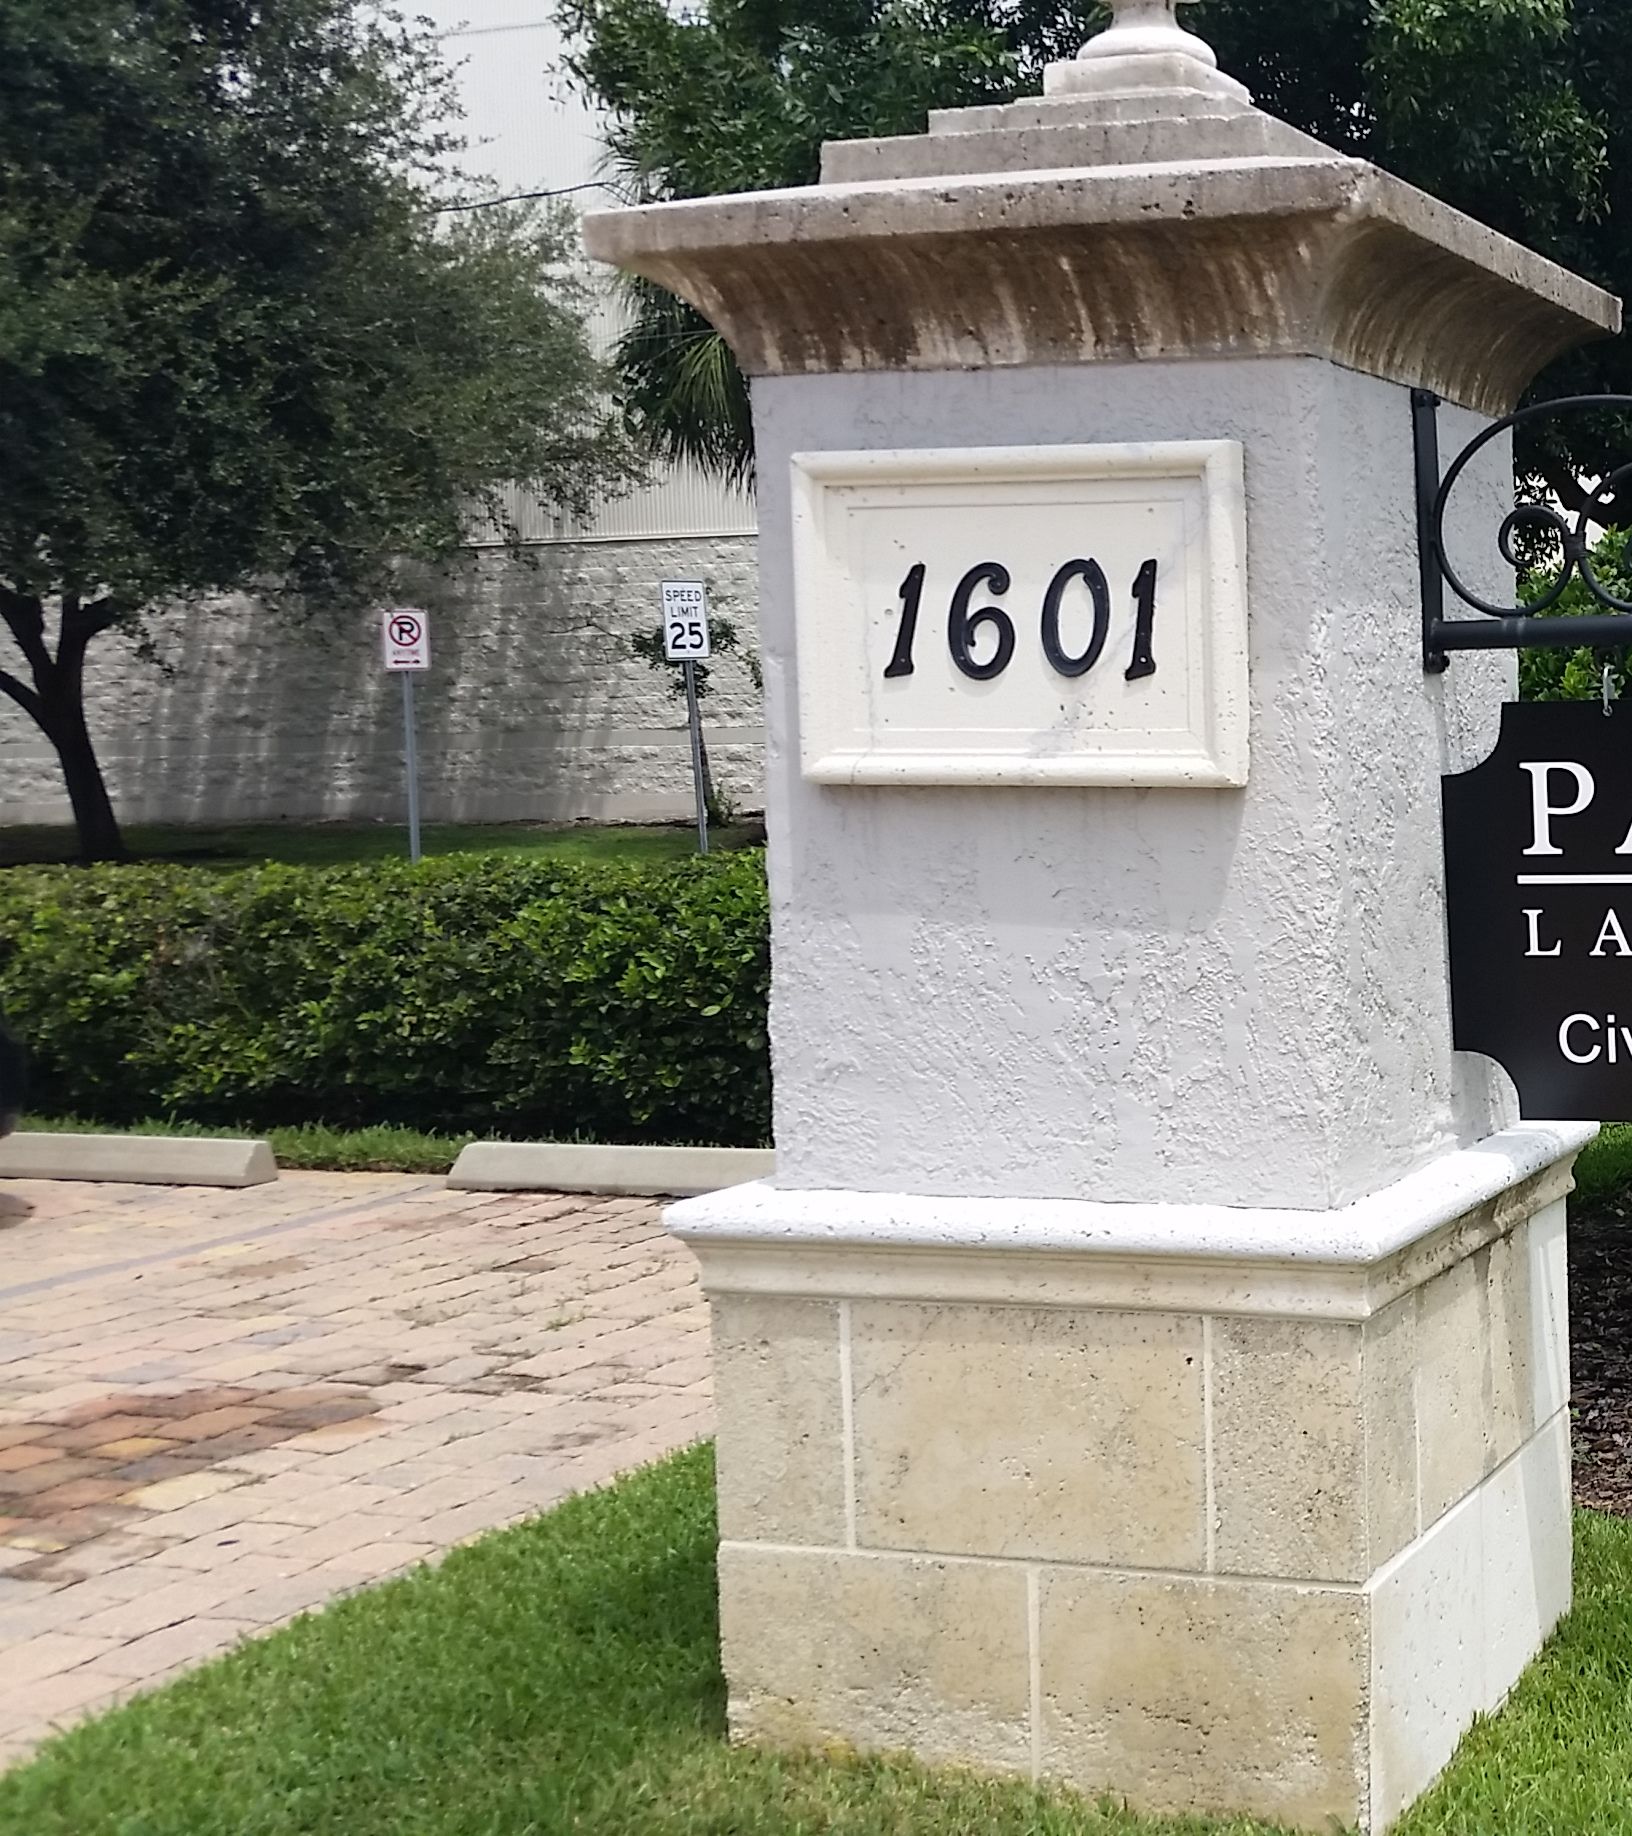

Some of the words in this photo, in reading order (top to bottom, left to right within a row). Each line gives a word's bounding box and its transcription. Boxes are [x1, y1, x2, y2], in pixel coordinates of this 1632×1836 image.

[665, 589, 702, 602] SPEED
[670, 606, 699, 618] LIMIT
[883, 557, 1158, 681] 1601
[669, 622, 704, 650] 25
